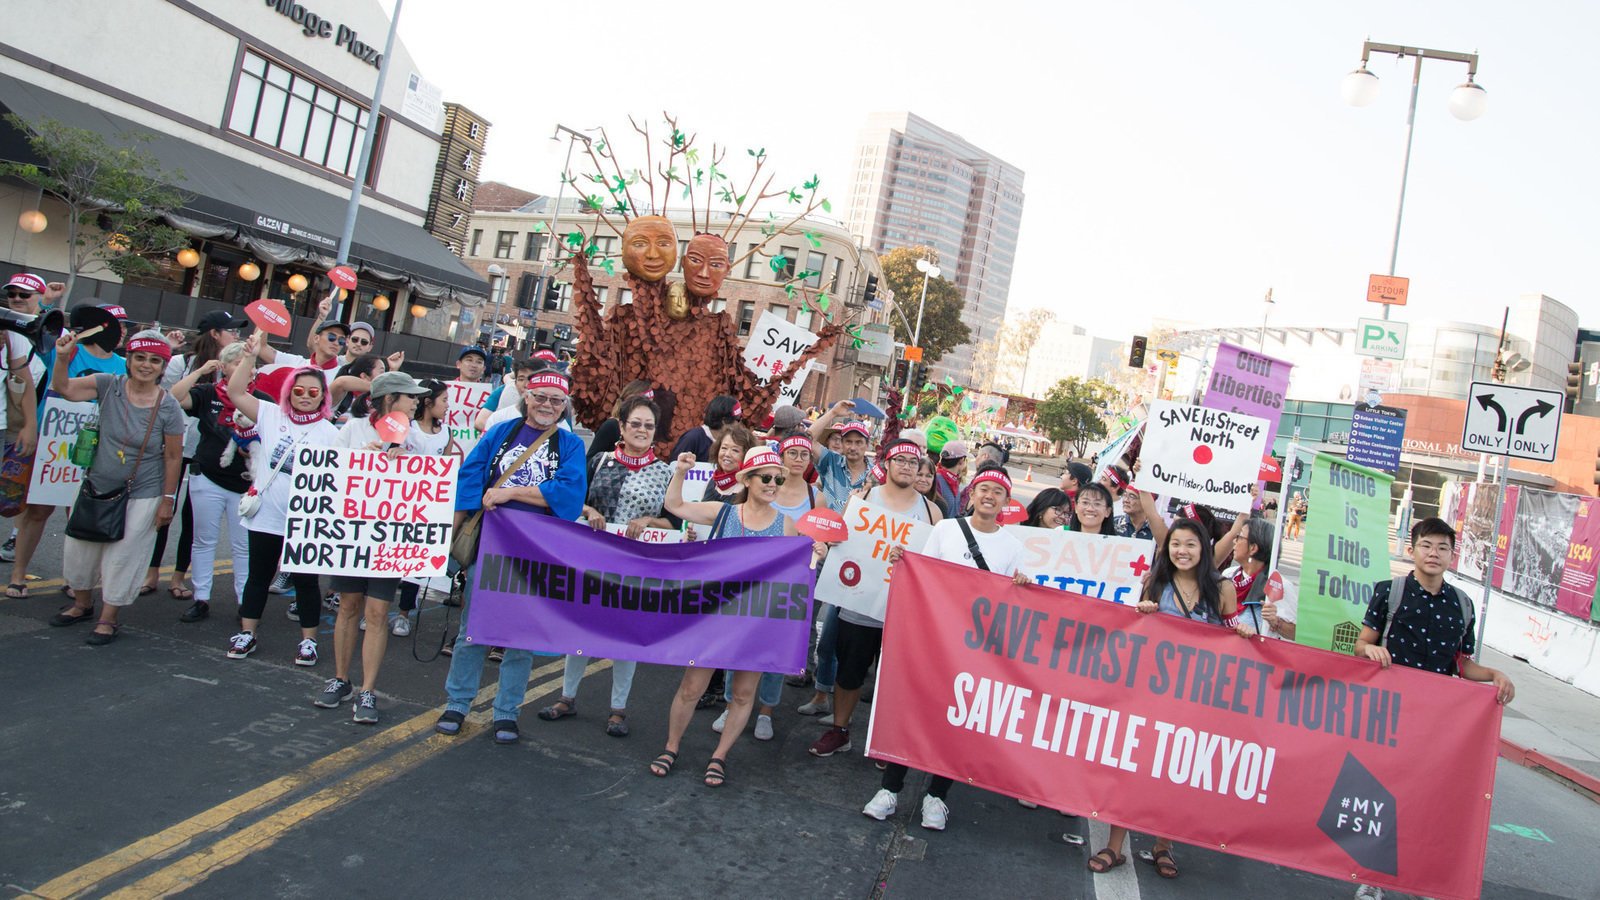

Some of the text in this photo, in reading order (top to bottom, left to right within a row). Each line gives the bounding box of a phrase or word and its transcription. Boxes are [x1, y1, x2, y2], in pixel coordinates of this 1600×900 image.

[257, 216, 281, 231] GAZEN
[1371, 285, 1405, 295] DETOUR
[752, 354, 785, 375] 小東
[1236, 351, 1273, 378] Civil
[541, 375, 560, 384] LITTLE
[1210, 372, 1282, 409] Liberties
[1160, 407, 1200, 428] SAVE
[1216, 412, 1260, 441] Street
[1190, 427, 1235, 449] North
[1402, 439, 1442, 453] TIONAL
[1469, 433, 1503, 448] ONLY
[1514, 440, 1549, 454] ONLY
[300, 448, 339, 469] OUR
[349, 452, 454, 477] HISTORY
[753, 454, 766, 465] SAVE
[40, 464, 80, 485] FUEL
[685, 470, 714, 481] ITTL
[1152, 463, 1178, 484] Our
[1329, 462, 1376, 497] Home
[295, 473, 451, 502] OUR FUTURE
[289, 495, 429, 523] OUR BLOCK
[1345, 502, 1358, 529] is
[287, 518, 452, 544] FIRST STREET
[854, 507, 914, 545] SAVE
[283, 542, 430, 569] NORTH little
[872, 540, 891, 561] FI
[1024, 537, 1132, 583] SAVE
[1328, 534, 1370, 568] Little
[1568, 543, 1593, 562] 1934
[371, 558, 427, 577] tokyo
[478, 553, 809, 621] NIKKEI PROGRESSIVES
[964, 597, 1402, 748] SAVE FIRST STREET NORTH!
[947, 672, 1276, 804] SAVE LITTLE TOKYO!
[1341, 797, 1384, 817] #MY
[1337, 813, 1381, 837] FSN
